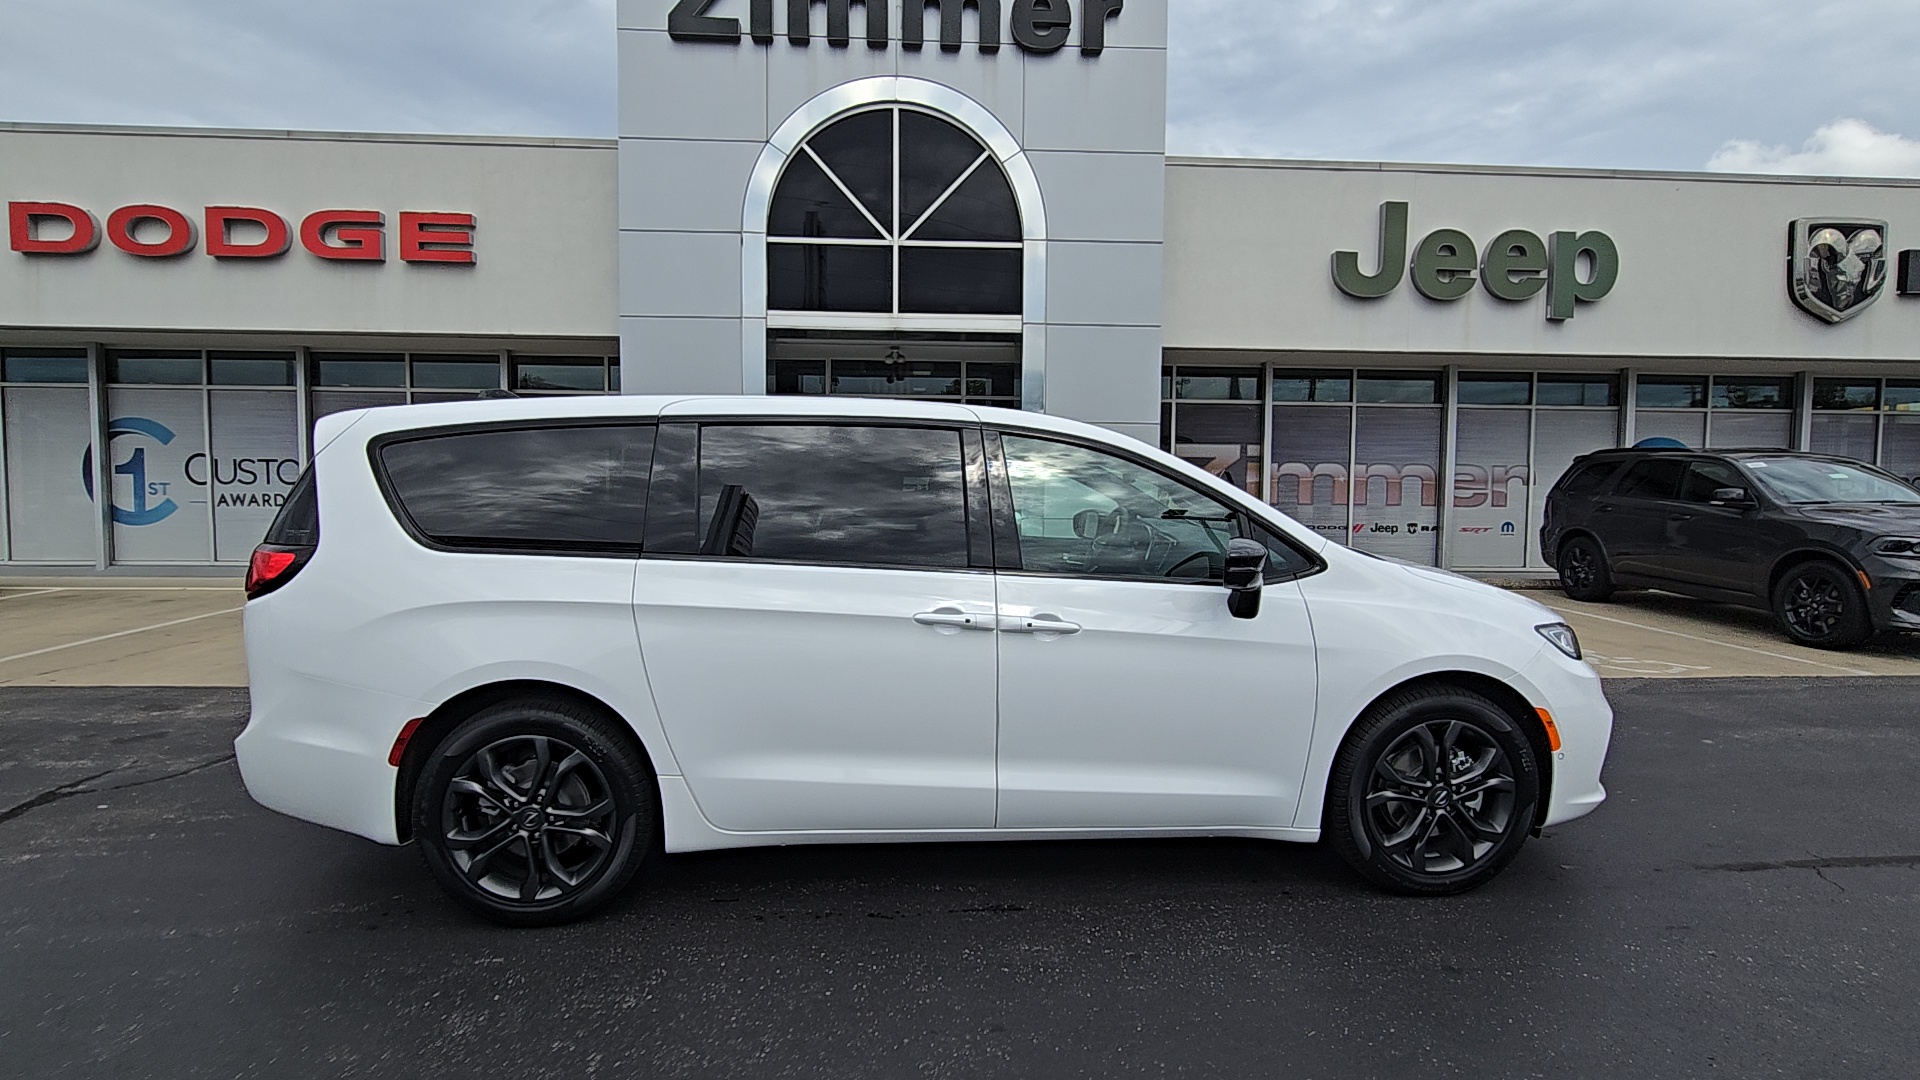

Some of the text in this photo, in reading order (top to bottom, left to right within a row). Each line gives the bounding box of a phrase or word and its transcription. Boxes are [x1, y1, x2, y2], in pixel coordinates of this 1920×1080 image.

[8, 201, 476, 265] DODGE
[1331, 201, 1619, 322] Jeep
[1370, 522, 1399, 535] Jeep
